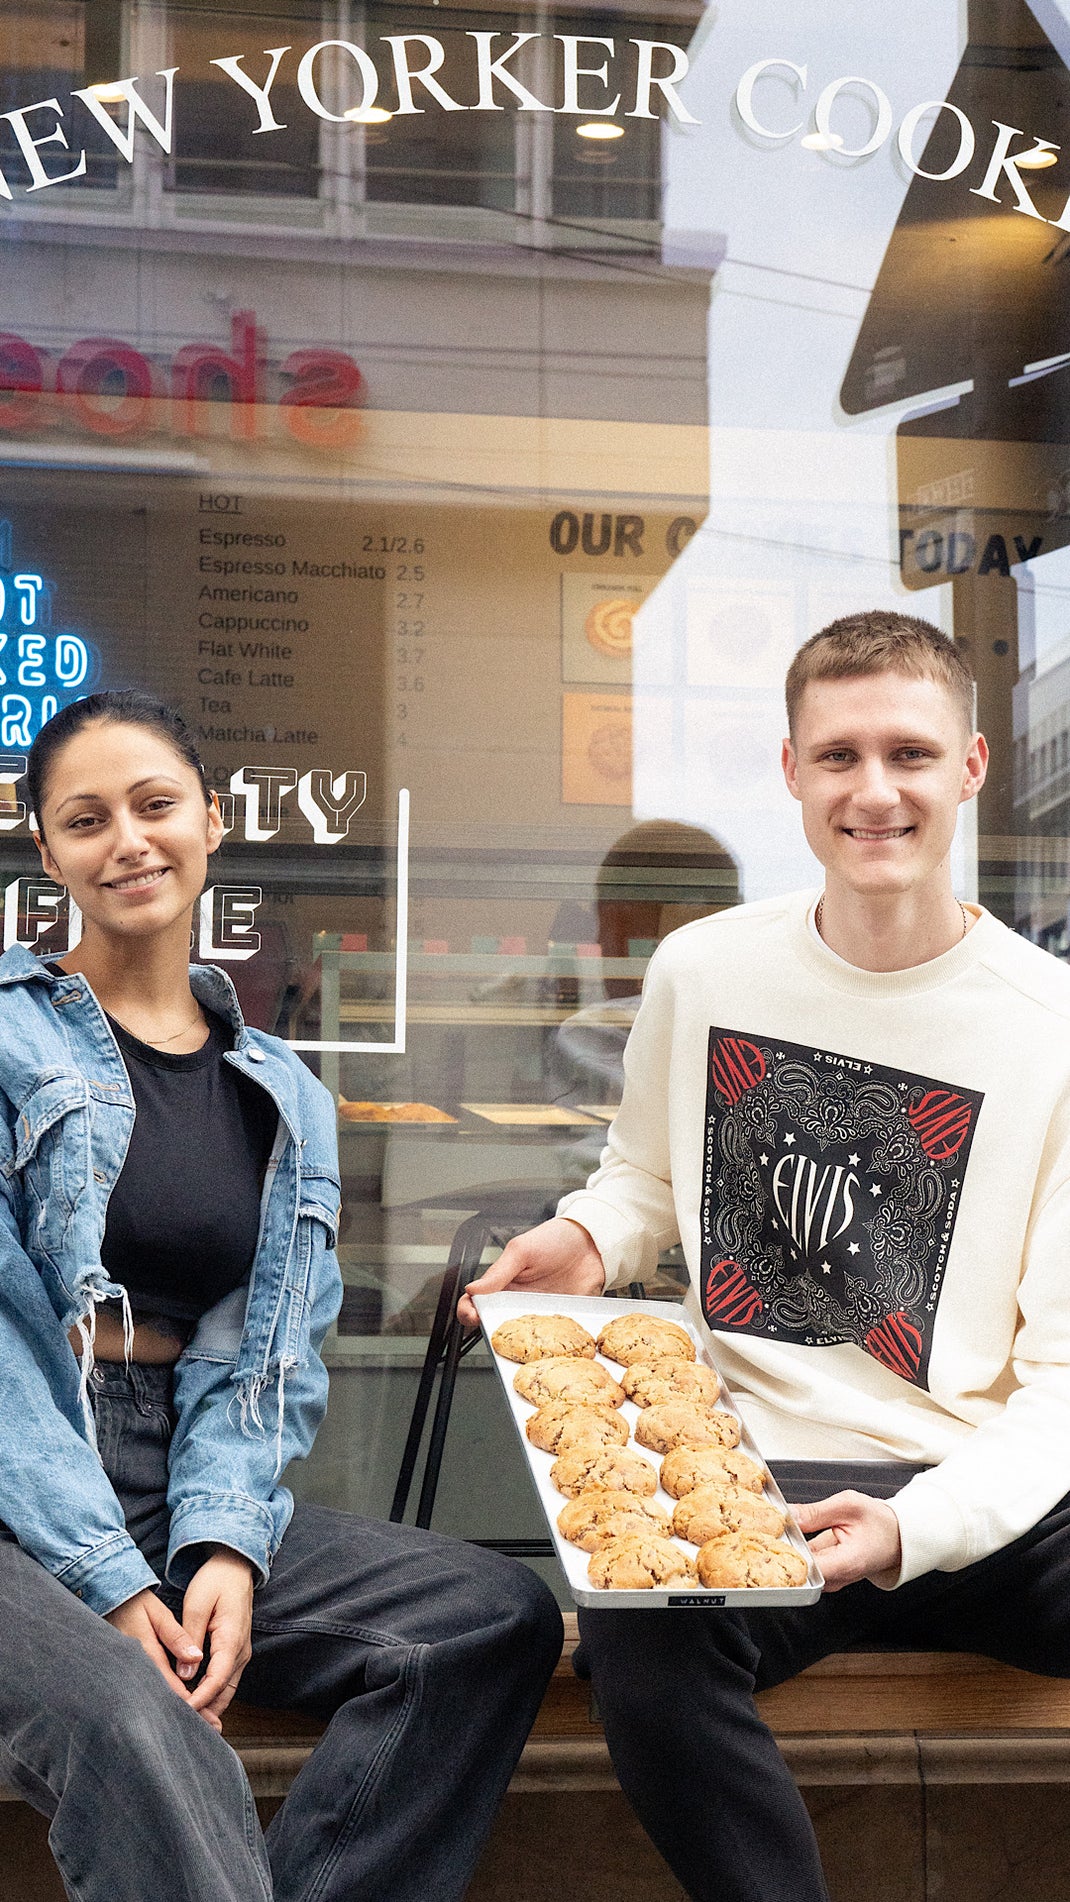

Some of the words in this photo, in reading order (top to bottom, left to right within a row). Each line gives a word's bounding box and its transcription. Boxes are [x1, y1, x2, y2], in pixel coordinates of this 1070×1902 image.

[0, 66, 180, 200] EW
[209, 31, 703, 135] YORKER
[199, 494, 243, 511] HOT
[199, 528, 287, 549] Espresso
[362, 535, 425, 556] 2.1/2.6
[550, 510, 645, 557] OUR
[898, 529, 1043, 577] TODAY
[199, 556, 286, 577] Espresso
[291, 559, 387, 580] Macchiato
[396, 565, 425, 582] 2.5
[199, 585, 299, 605] Americano
[396, 592, 425, 609] 2.7
[198, 612, 309, 634] Cappuccino
[396, 620, 425, 638] 3.2
[197, 640, 234, 659] Flat
[240, 641, 292, 660] White
[198, 667, 242, 686] Cafe
[248, 669, 295, 688] Latte
[199, 697, 232, 714] Tea
[198, 725, 265, 744] Matcha
[273, 727, 319, 745] Latte
[825, 1055, 861, 1072] ELVIS
[705, 1126, 714, 1184] SCOTCH
[704, 1186, 713, 1196] &
[703, 1198, 711, 1234] SODA
[773, 1153, 861, 1258] ELVIS
[944, 1191, 957, 1230] SODA
[941, 1232, 950, 1243] &
[930, 1243, 947, 1301] SCOTCH
[680, 1597, 725, 1605] WALNUT
